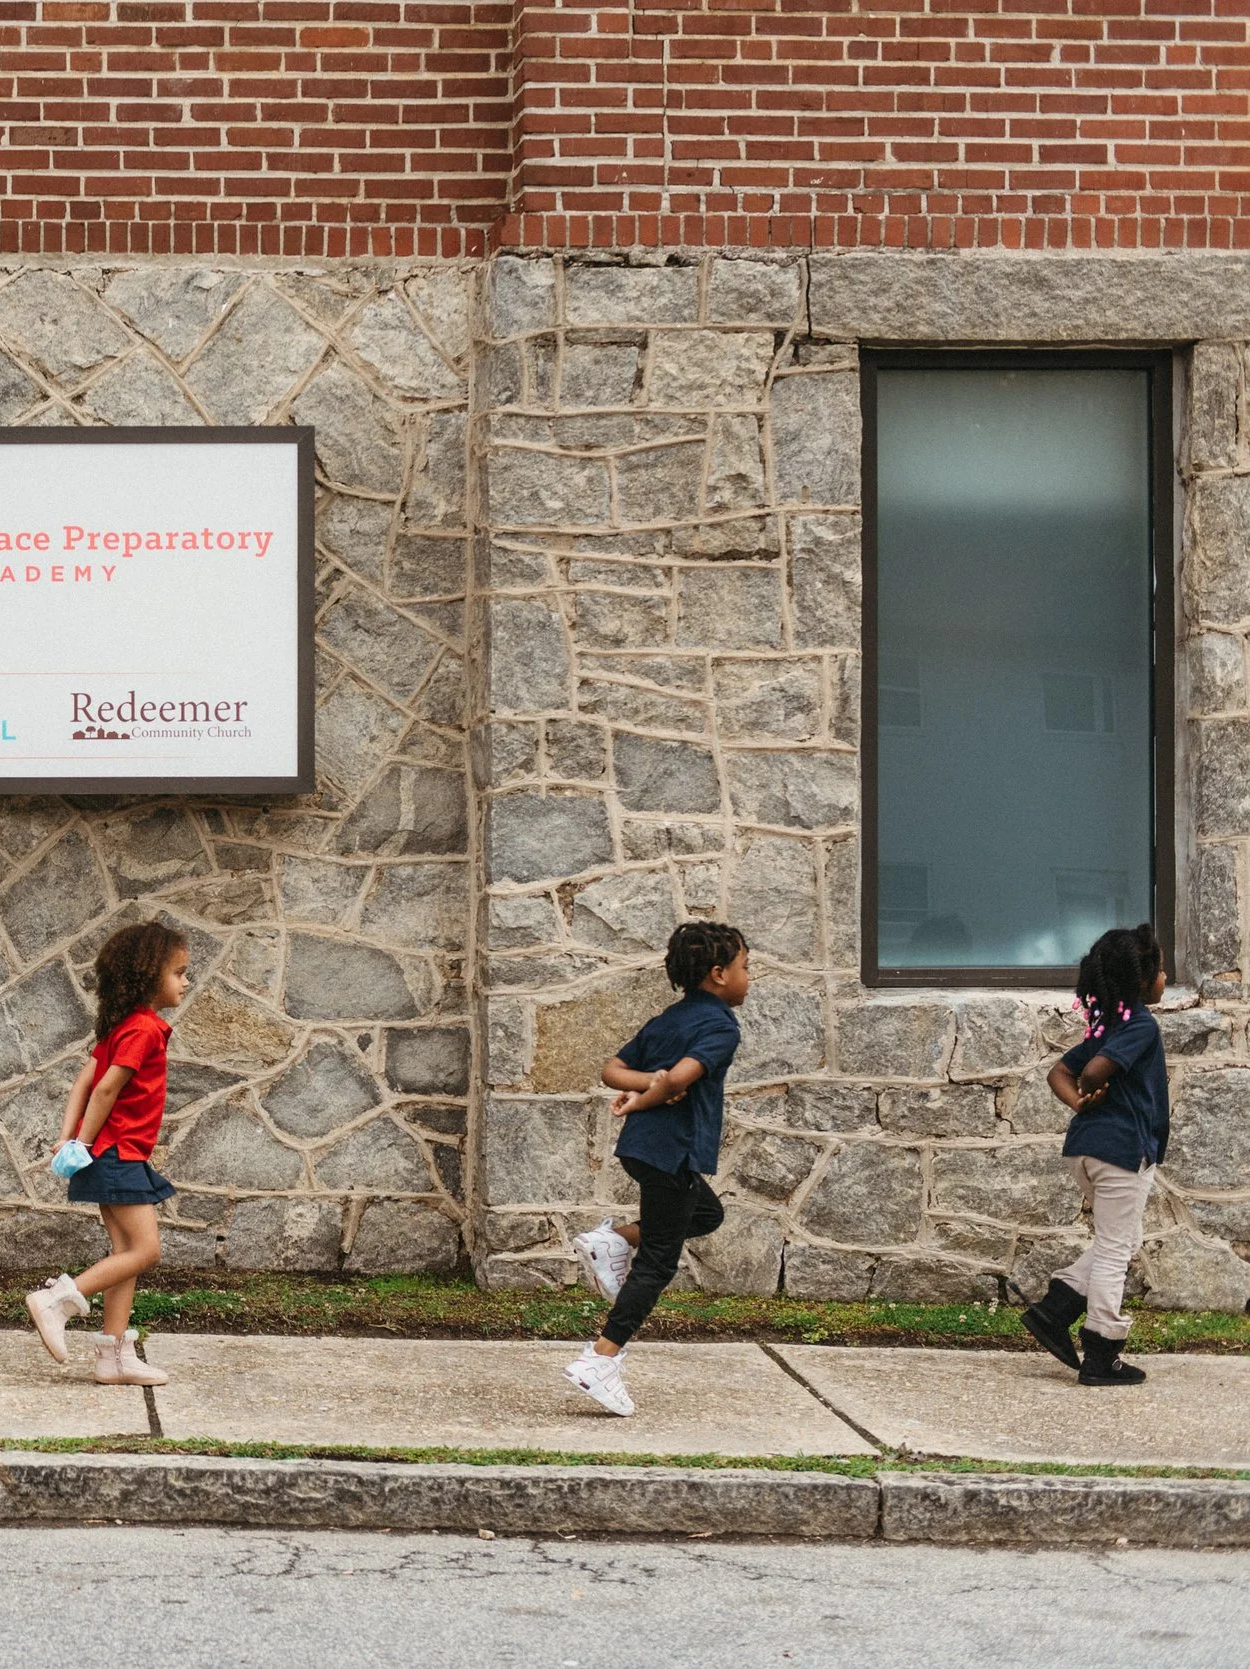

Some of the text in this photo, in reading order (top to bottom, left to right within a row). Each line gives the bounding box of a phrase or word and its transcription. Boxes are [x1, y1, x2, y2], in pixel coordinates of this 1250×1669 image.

[62, 525, 274, 557] Preparatory
[69, 690, 248, 723] Redeemer
[131, 725, 252, 741] Community Church
